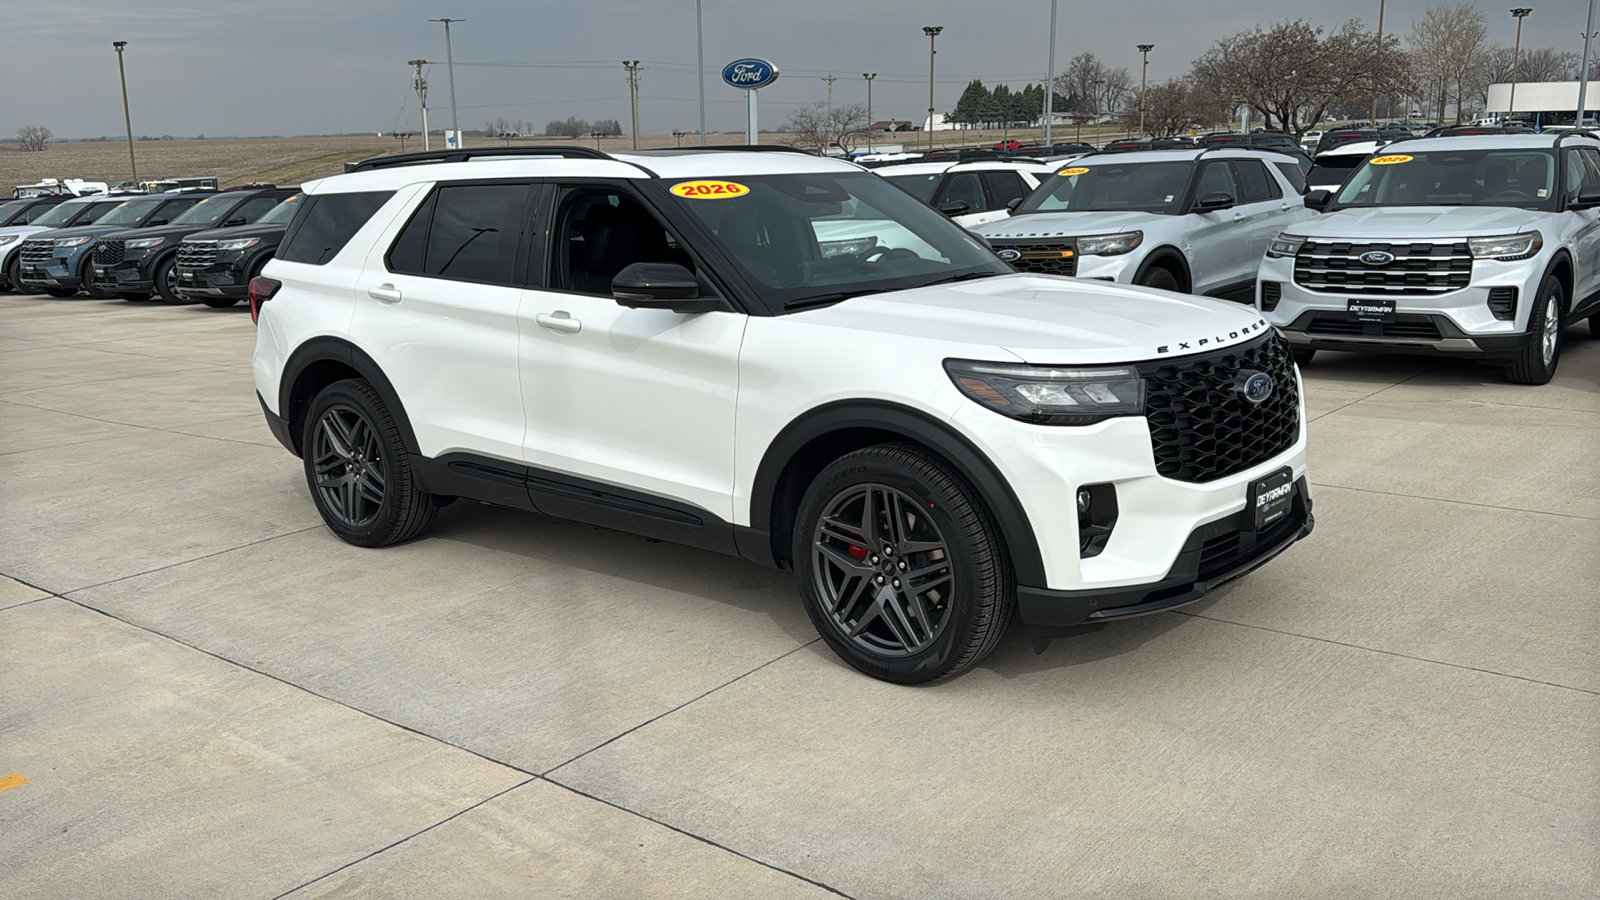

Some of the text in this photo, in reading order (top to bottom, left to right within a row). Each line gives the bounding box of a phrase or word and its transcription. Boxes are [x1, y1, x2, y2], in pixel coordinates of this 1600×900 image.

[731, 63, 763, 83] Ford
[681, 184, 741, 196] 2026
[1366, 253, 1387, 261] Ford
[1349, 305, 1393, 313] DEYARMAN
[1157, 319, 1266, 354] EXPLORER
[833, 466, 868, 482] ZERO
[1257, 482, 1292, 508] DEYARMAN
